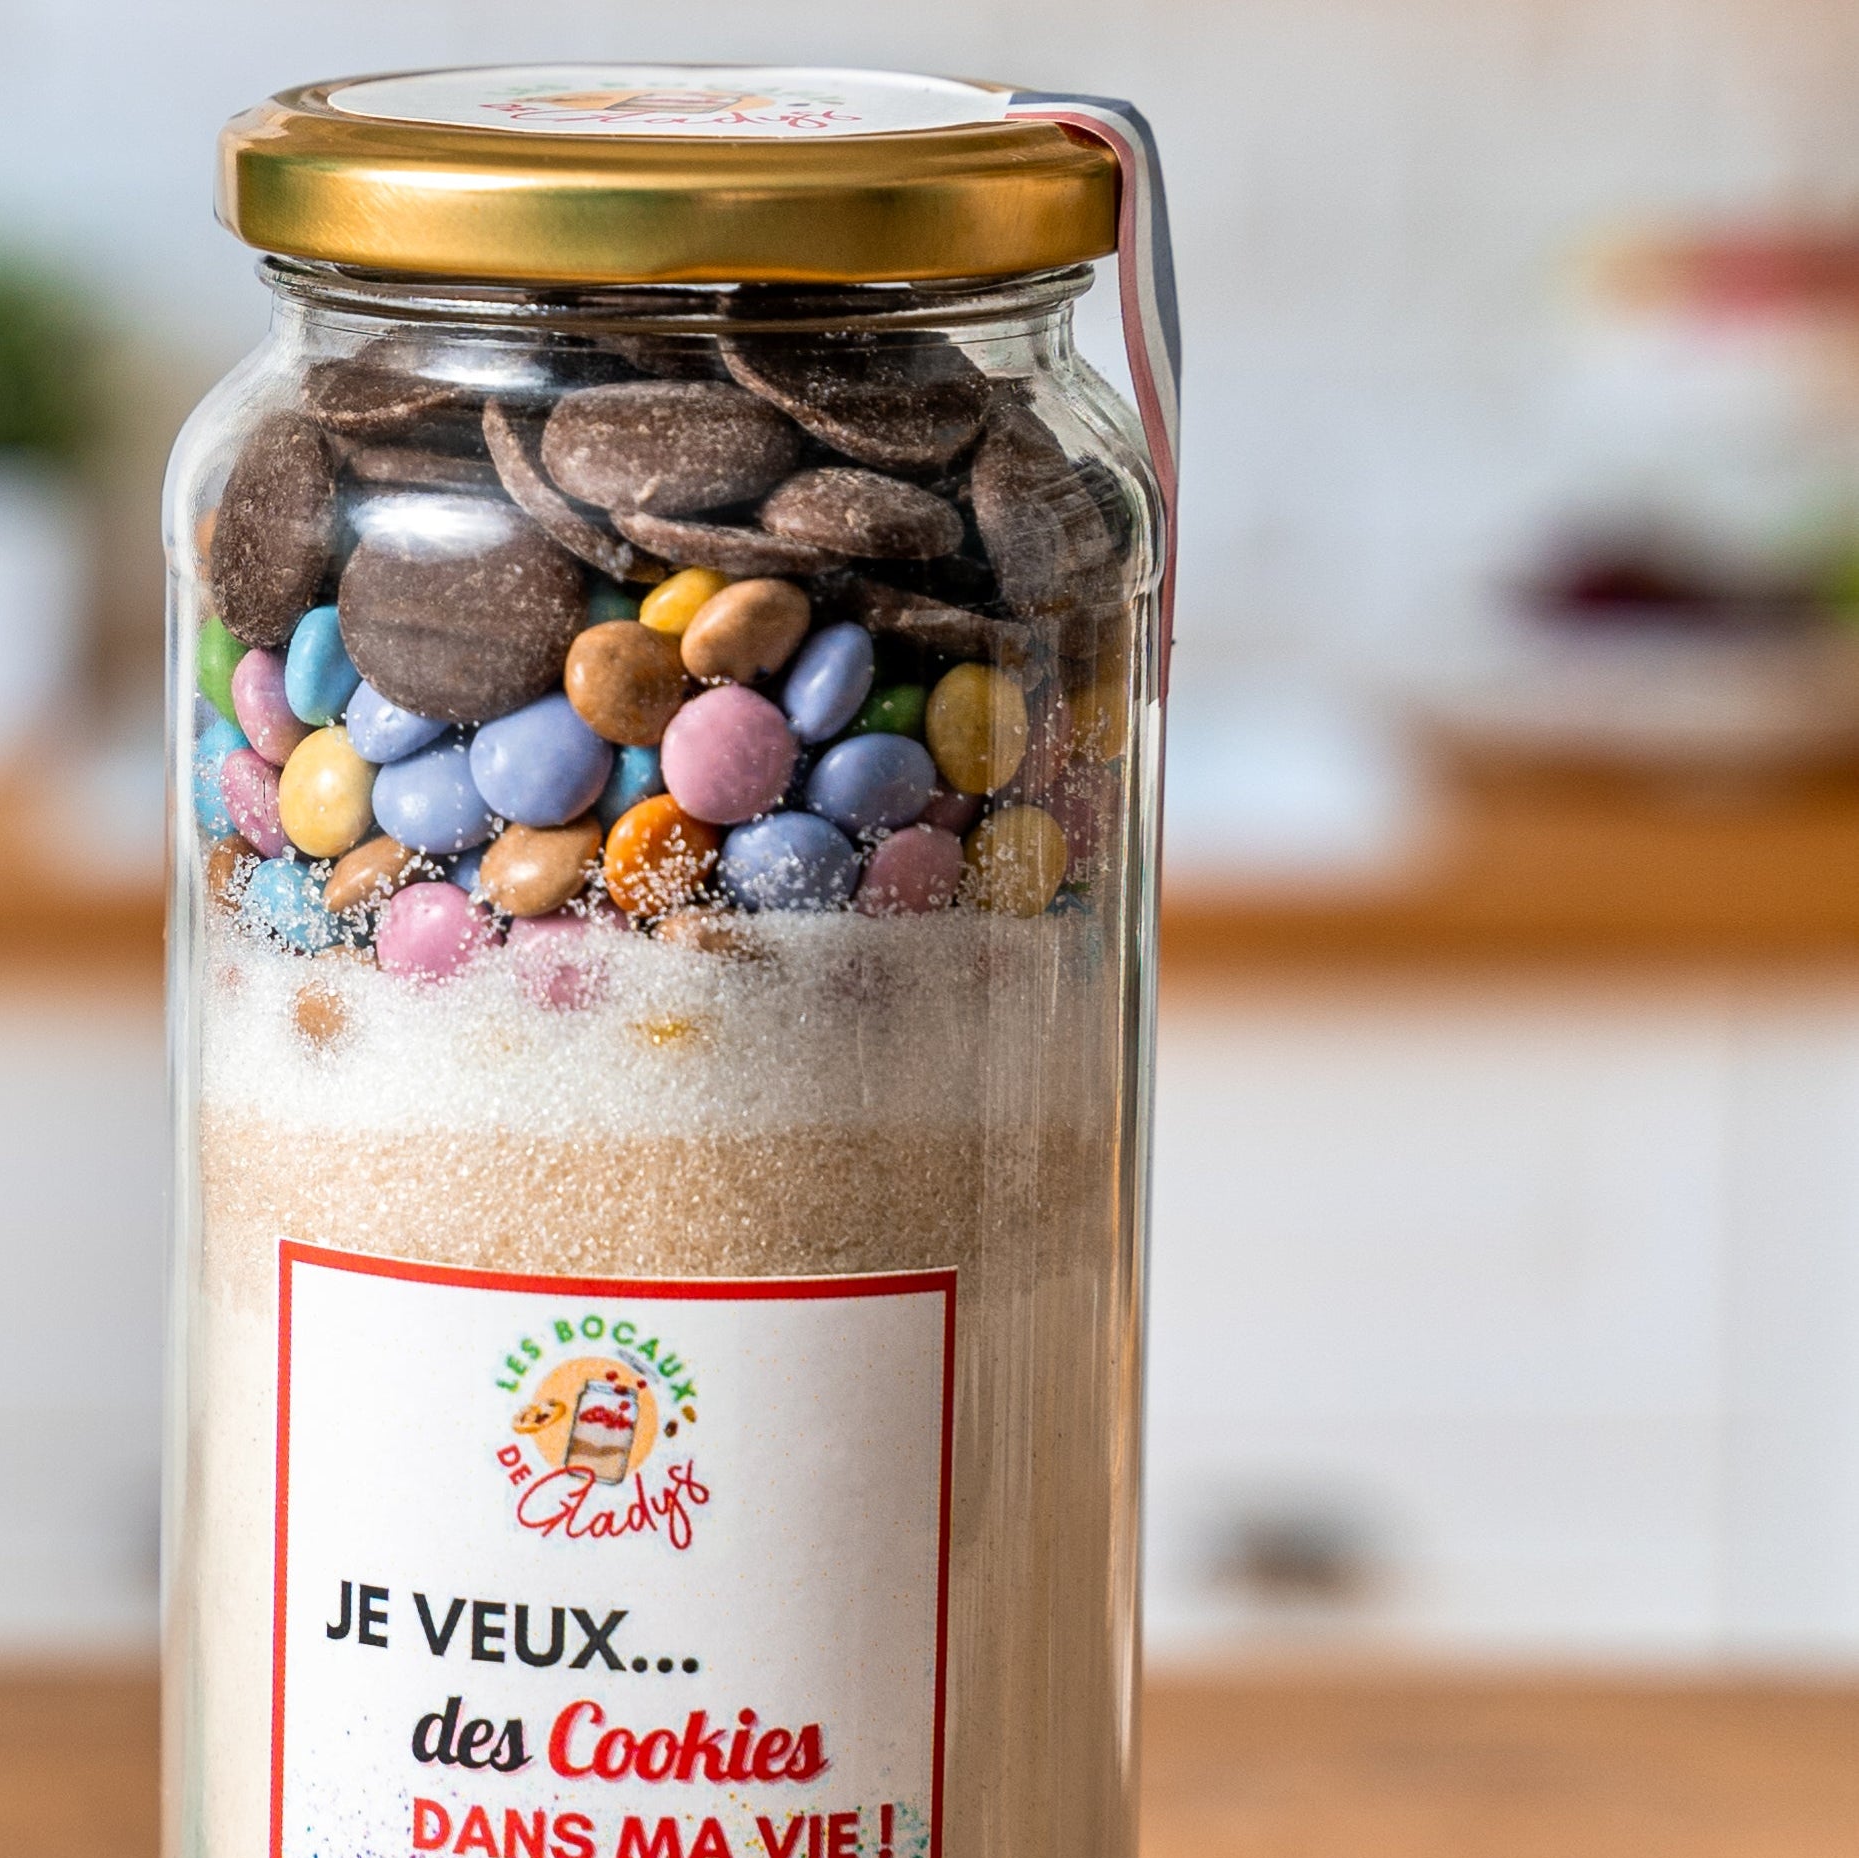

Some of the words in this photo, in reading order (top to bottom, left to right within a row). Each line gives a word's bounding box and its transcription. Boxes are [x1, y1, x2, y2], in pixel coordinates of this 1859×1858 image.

[495, 1337, 542, 1393] LES
[552, 1314, 698, 1402] BOCAUX
[496, 1444, 533, 1487] DE
[517, 1458, 711, 1551] Gladys
[326, 1580, 390, 1649] JE
[412, 1591, 700, 1674] VEUX...
[411, 1696, 534, 1773] des
[547, 1700, 831, 1784] Cookies
